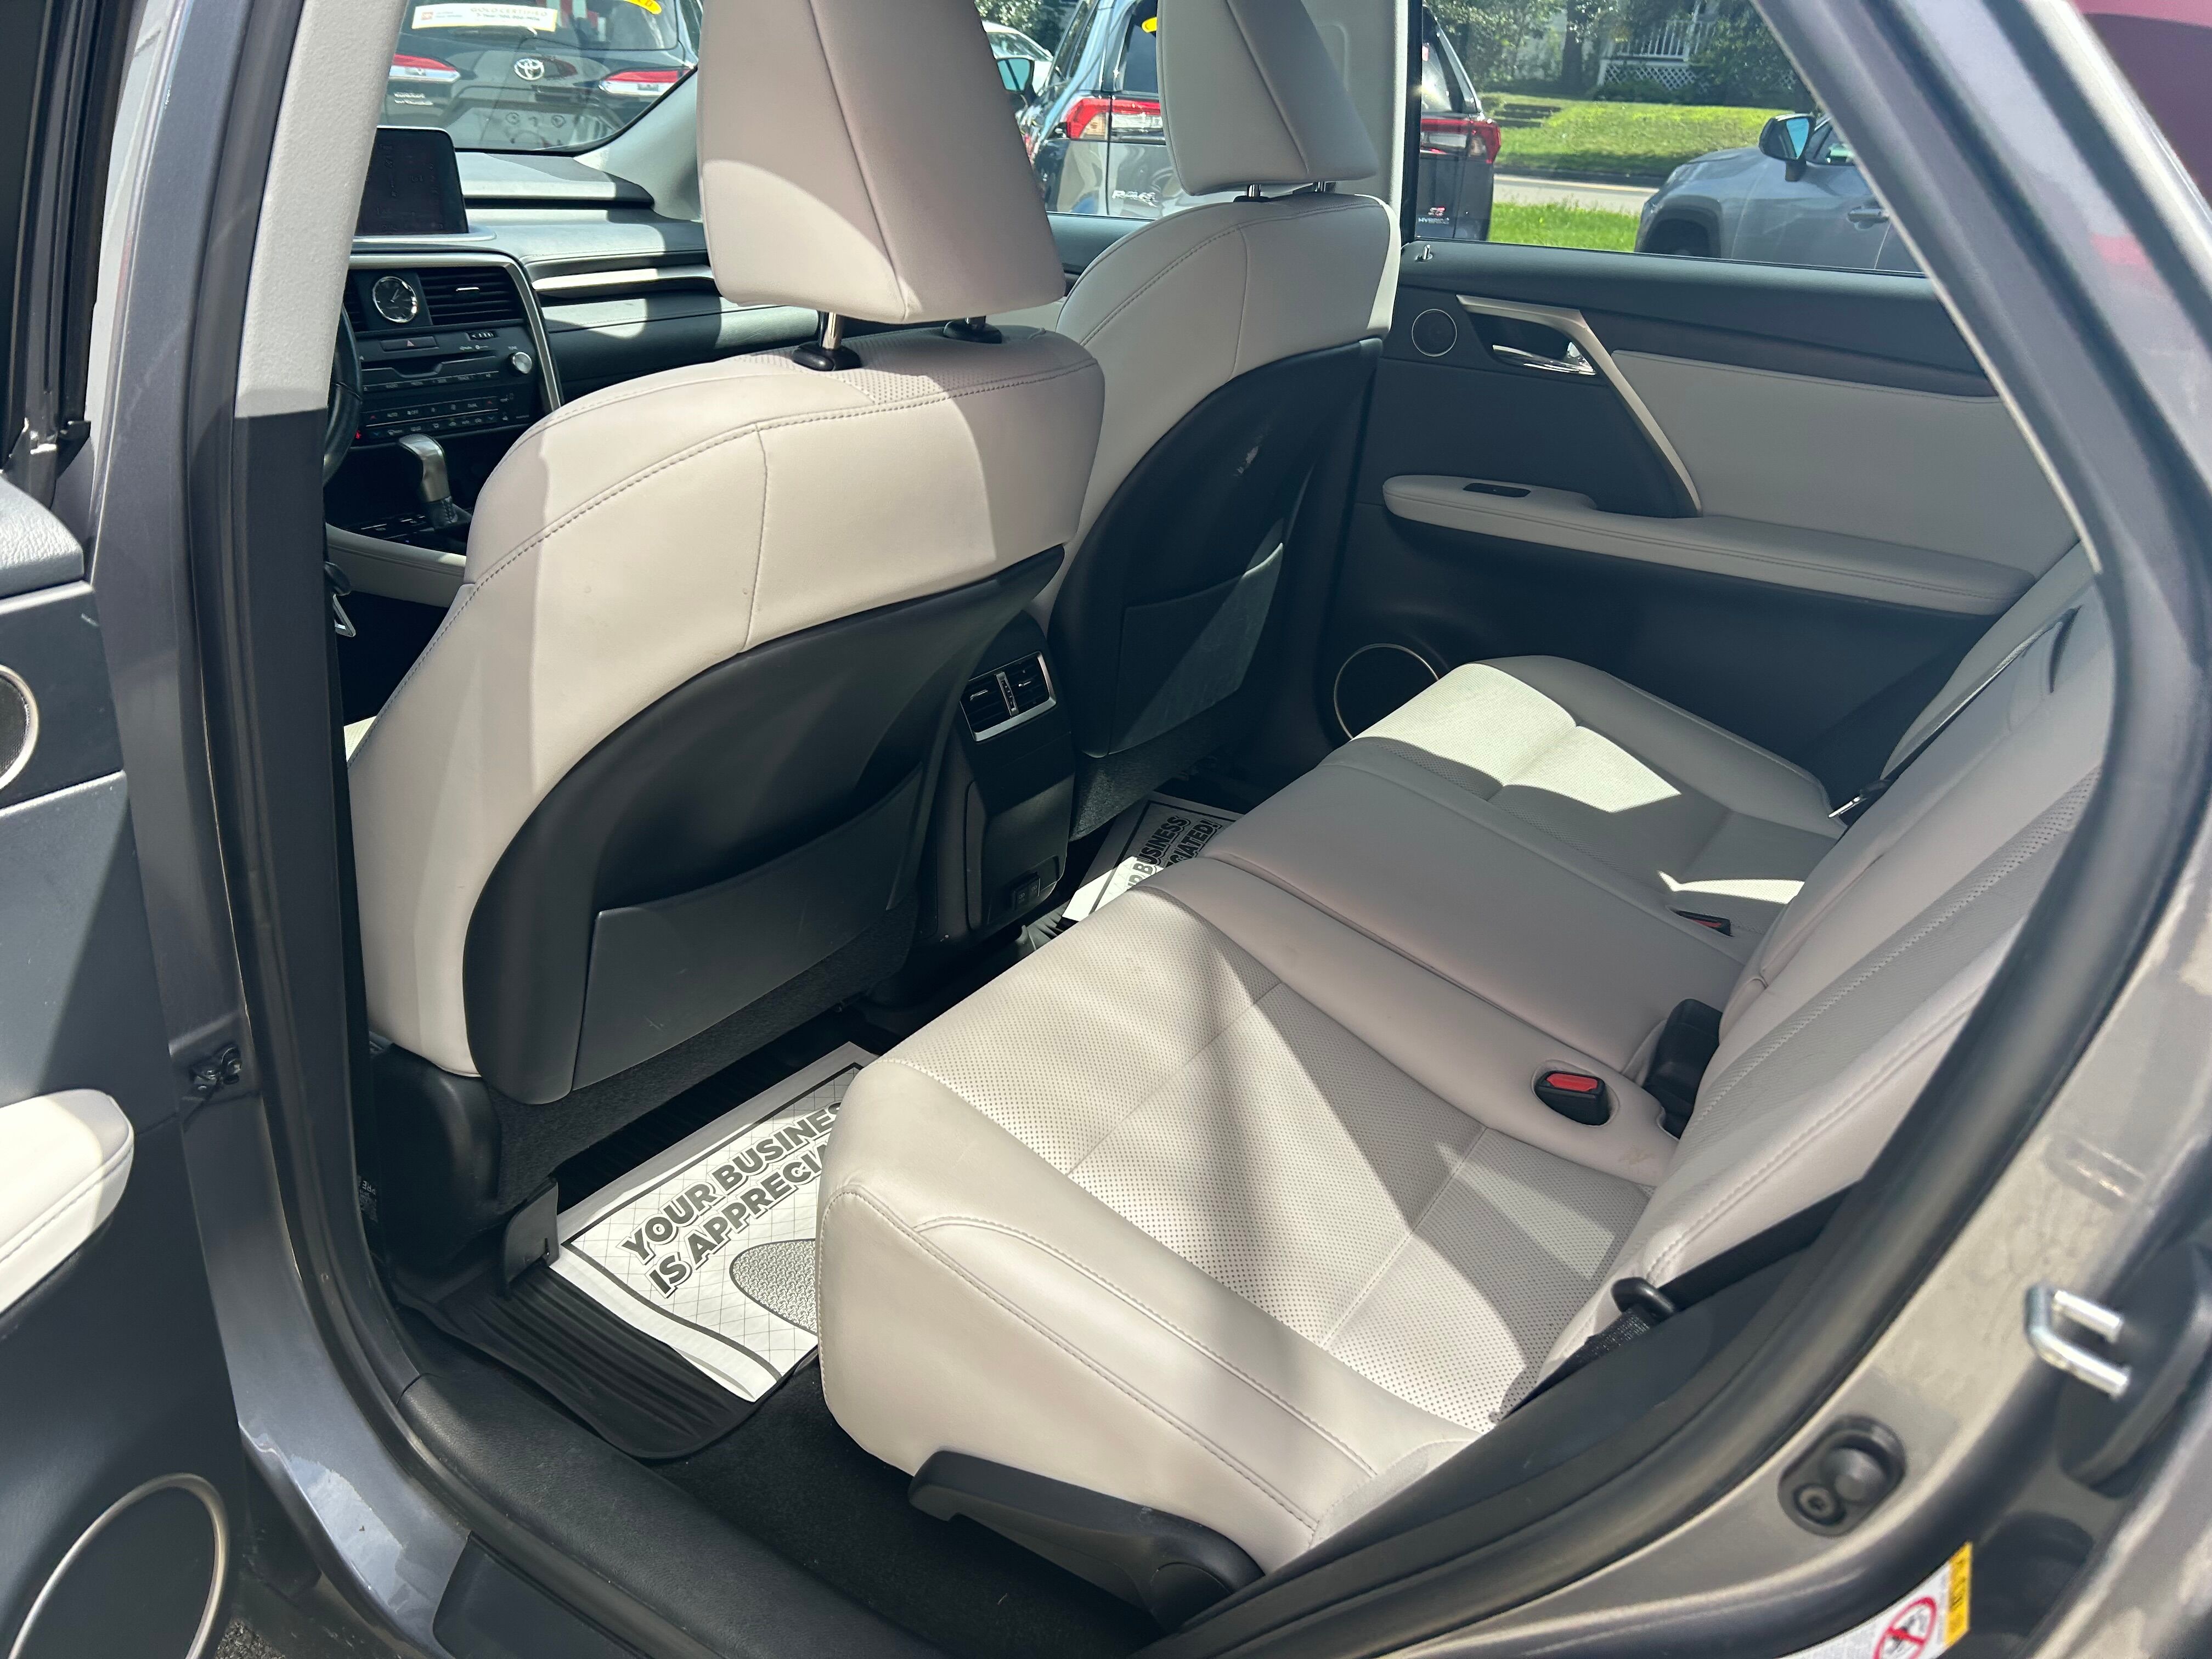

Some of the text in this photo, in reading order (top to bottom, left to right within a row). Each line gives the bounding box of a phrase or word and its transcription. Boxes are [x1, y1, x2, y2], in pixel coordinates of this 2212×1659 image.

[1132, 815, 1188, 875] BUSINESS
[1166, 819, 1220, 868] CIATED!
[620, 1182, 719, 1263] YOUR
[648, 1144, 827, 1296] IS APPRECI
